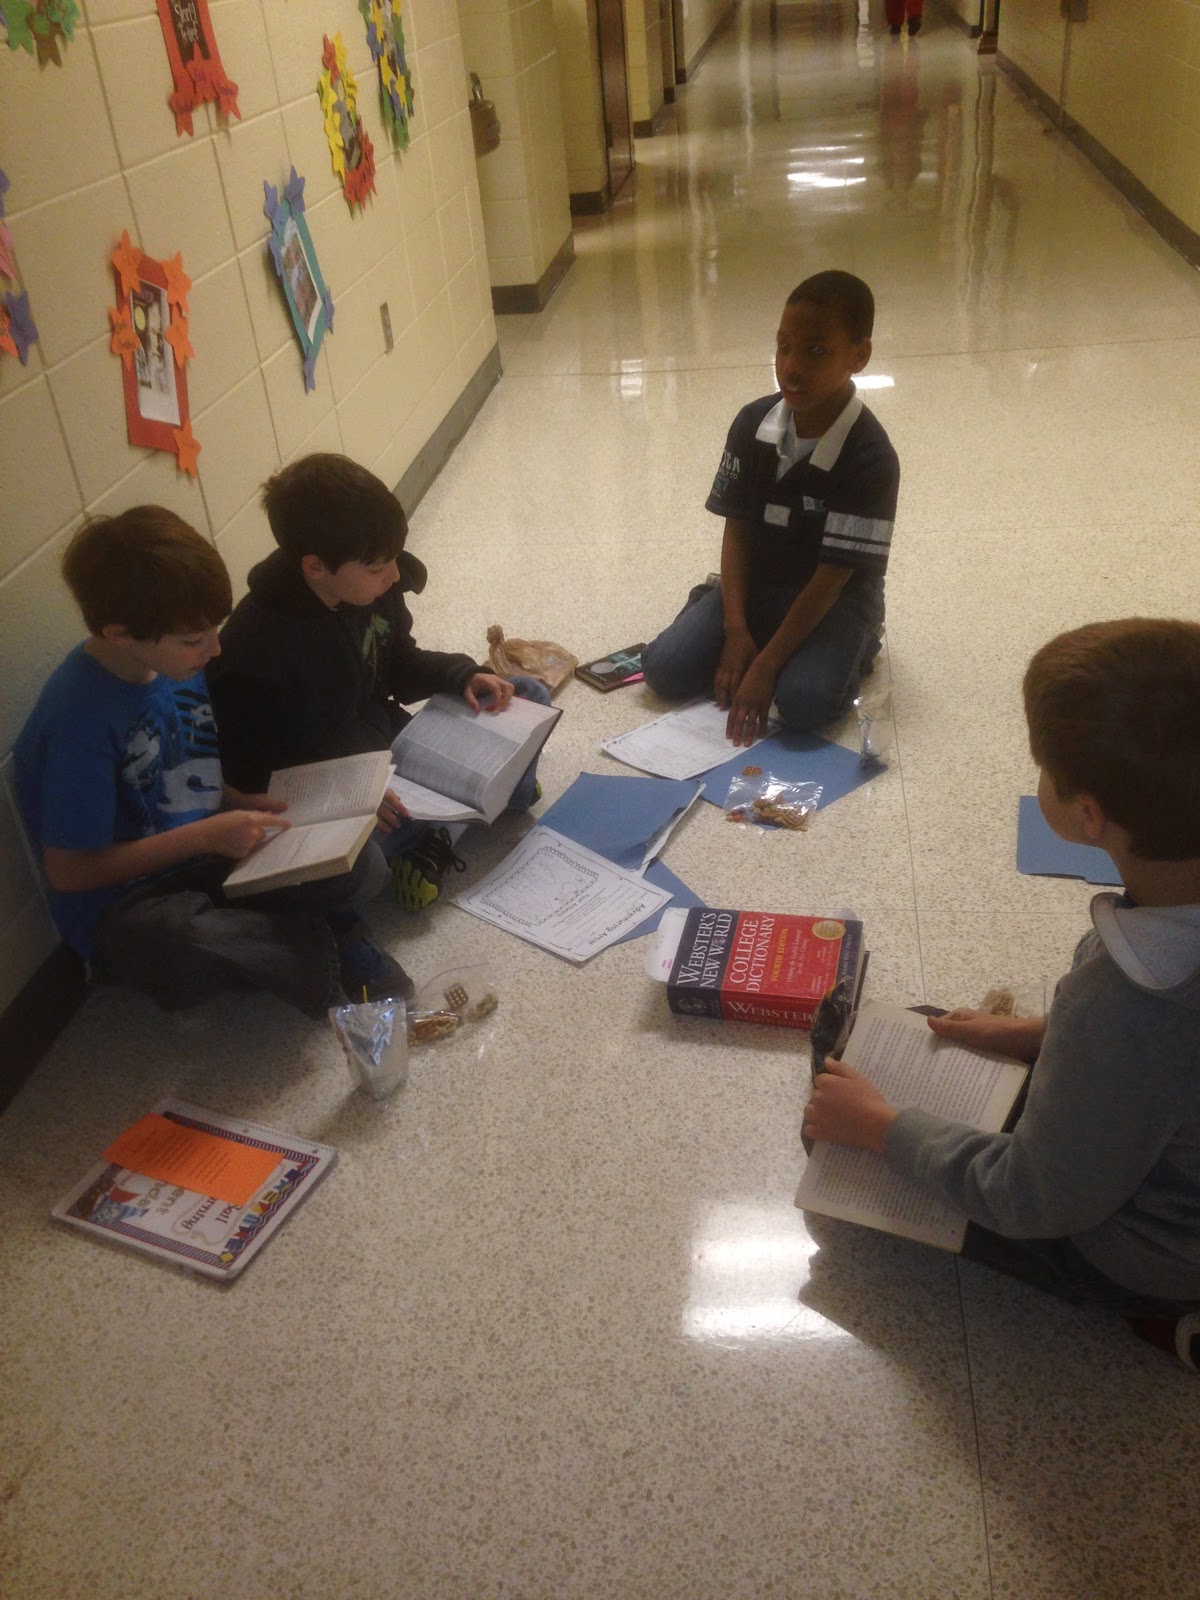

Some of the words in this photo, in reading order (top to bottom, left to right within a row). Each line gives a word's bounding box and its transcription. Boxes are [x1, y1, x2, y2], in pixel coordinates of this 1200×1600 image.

[605, 903, 646, 932] Adventuring
[588, 931, 608, 946] Artist
[676, 912, 717, 986] WEBSTER'S
[729, 919, 759, 984] COLLEGE
[746, 915, 775, 992] DICTIONARY
[771, 952, 782, 982] FOURTH
[778, 928, 789, 953] EDITION
[700, 957, 721, 988] NEW
[728, 1001, 812, 1021] WEBSTER
[156, 1187, 185, 1215] ent
[181, 1196, 218, 1230] arning
